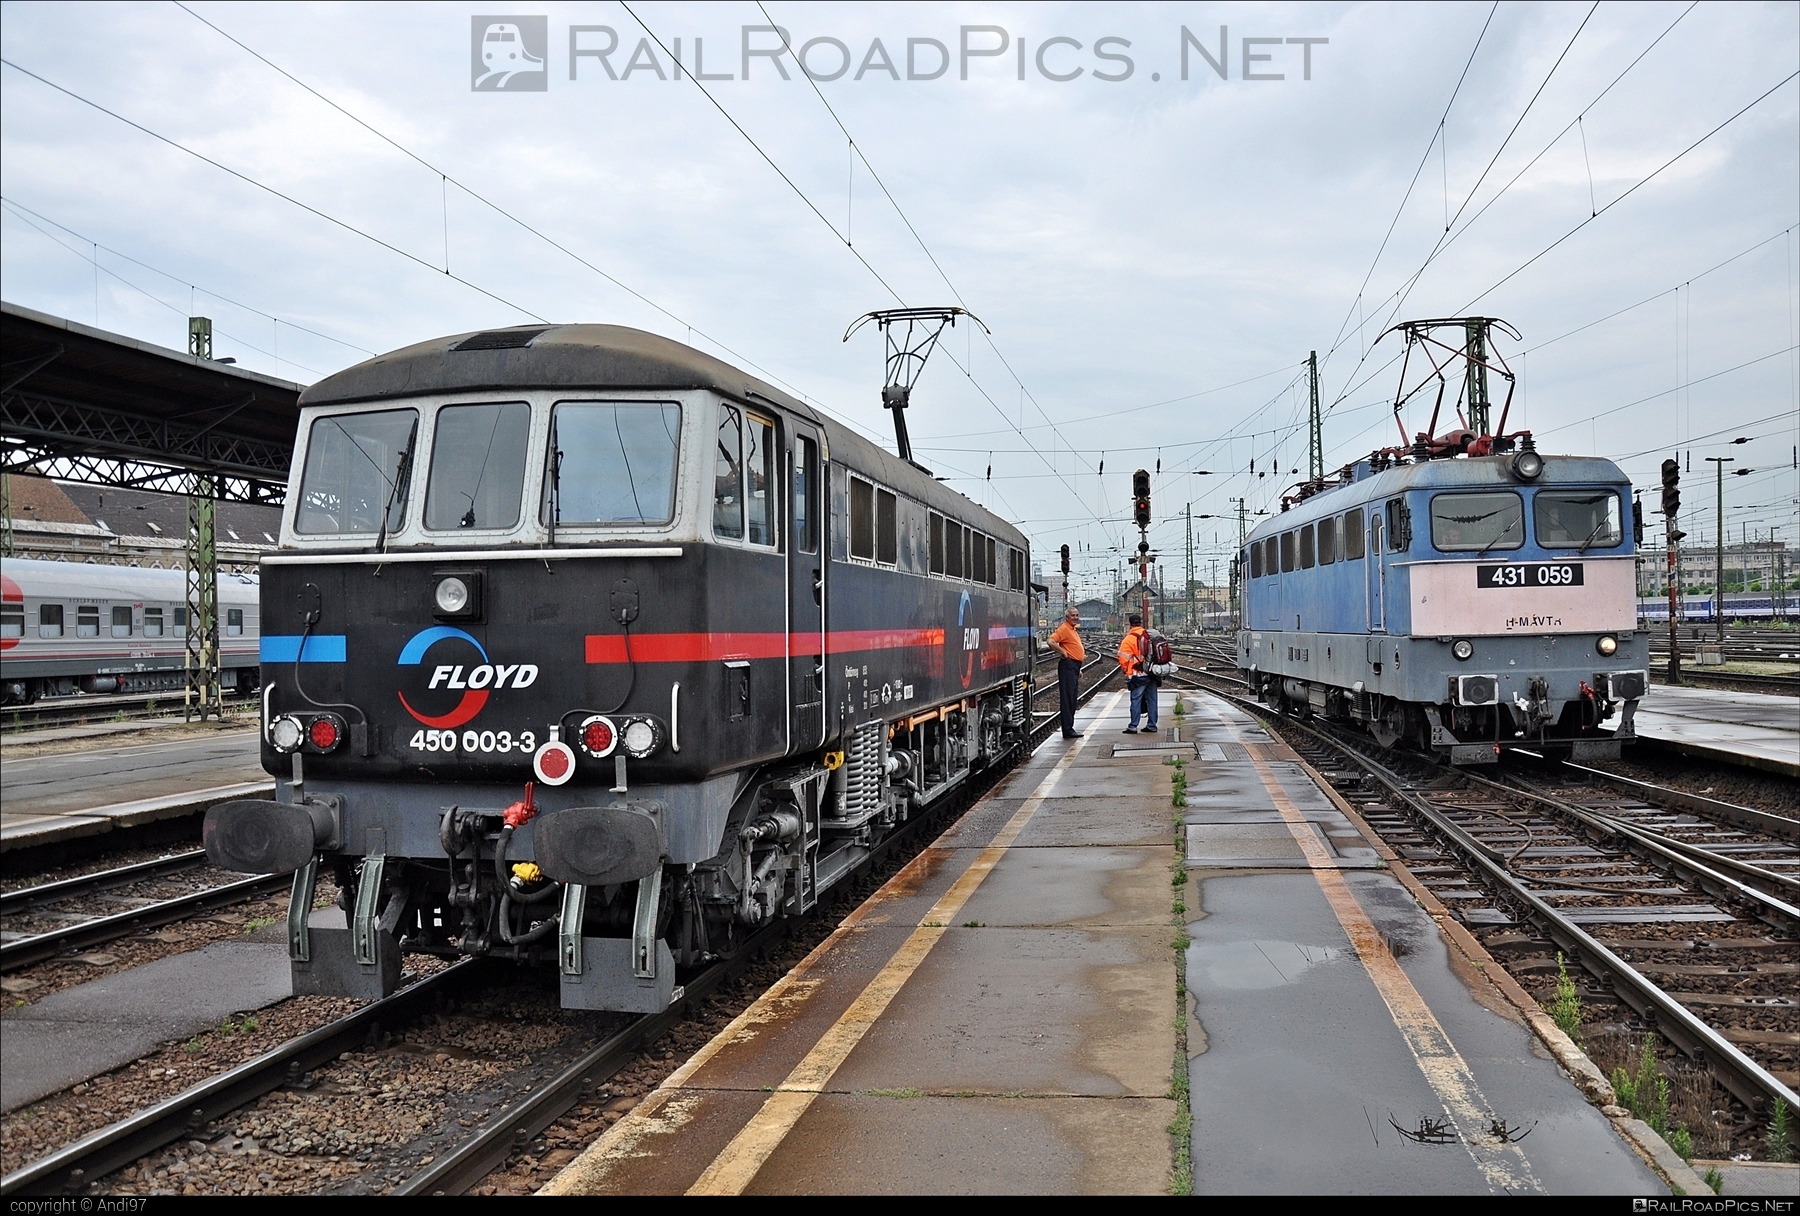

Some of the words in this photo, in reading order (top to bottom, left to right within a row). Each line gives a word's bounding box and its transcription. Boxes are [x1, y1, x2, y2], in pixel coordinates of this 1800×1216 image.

[1491, 566, 1526, 586] 431
[1537, 565, 1574, 585] 059
[963, 627, 980, 651] FLOYD
[428, 664, 539, 690] FLOYD
[409, 729, 457, 751] 450
[462, 730, 536, 754] 003-3
